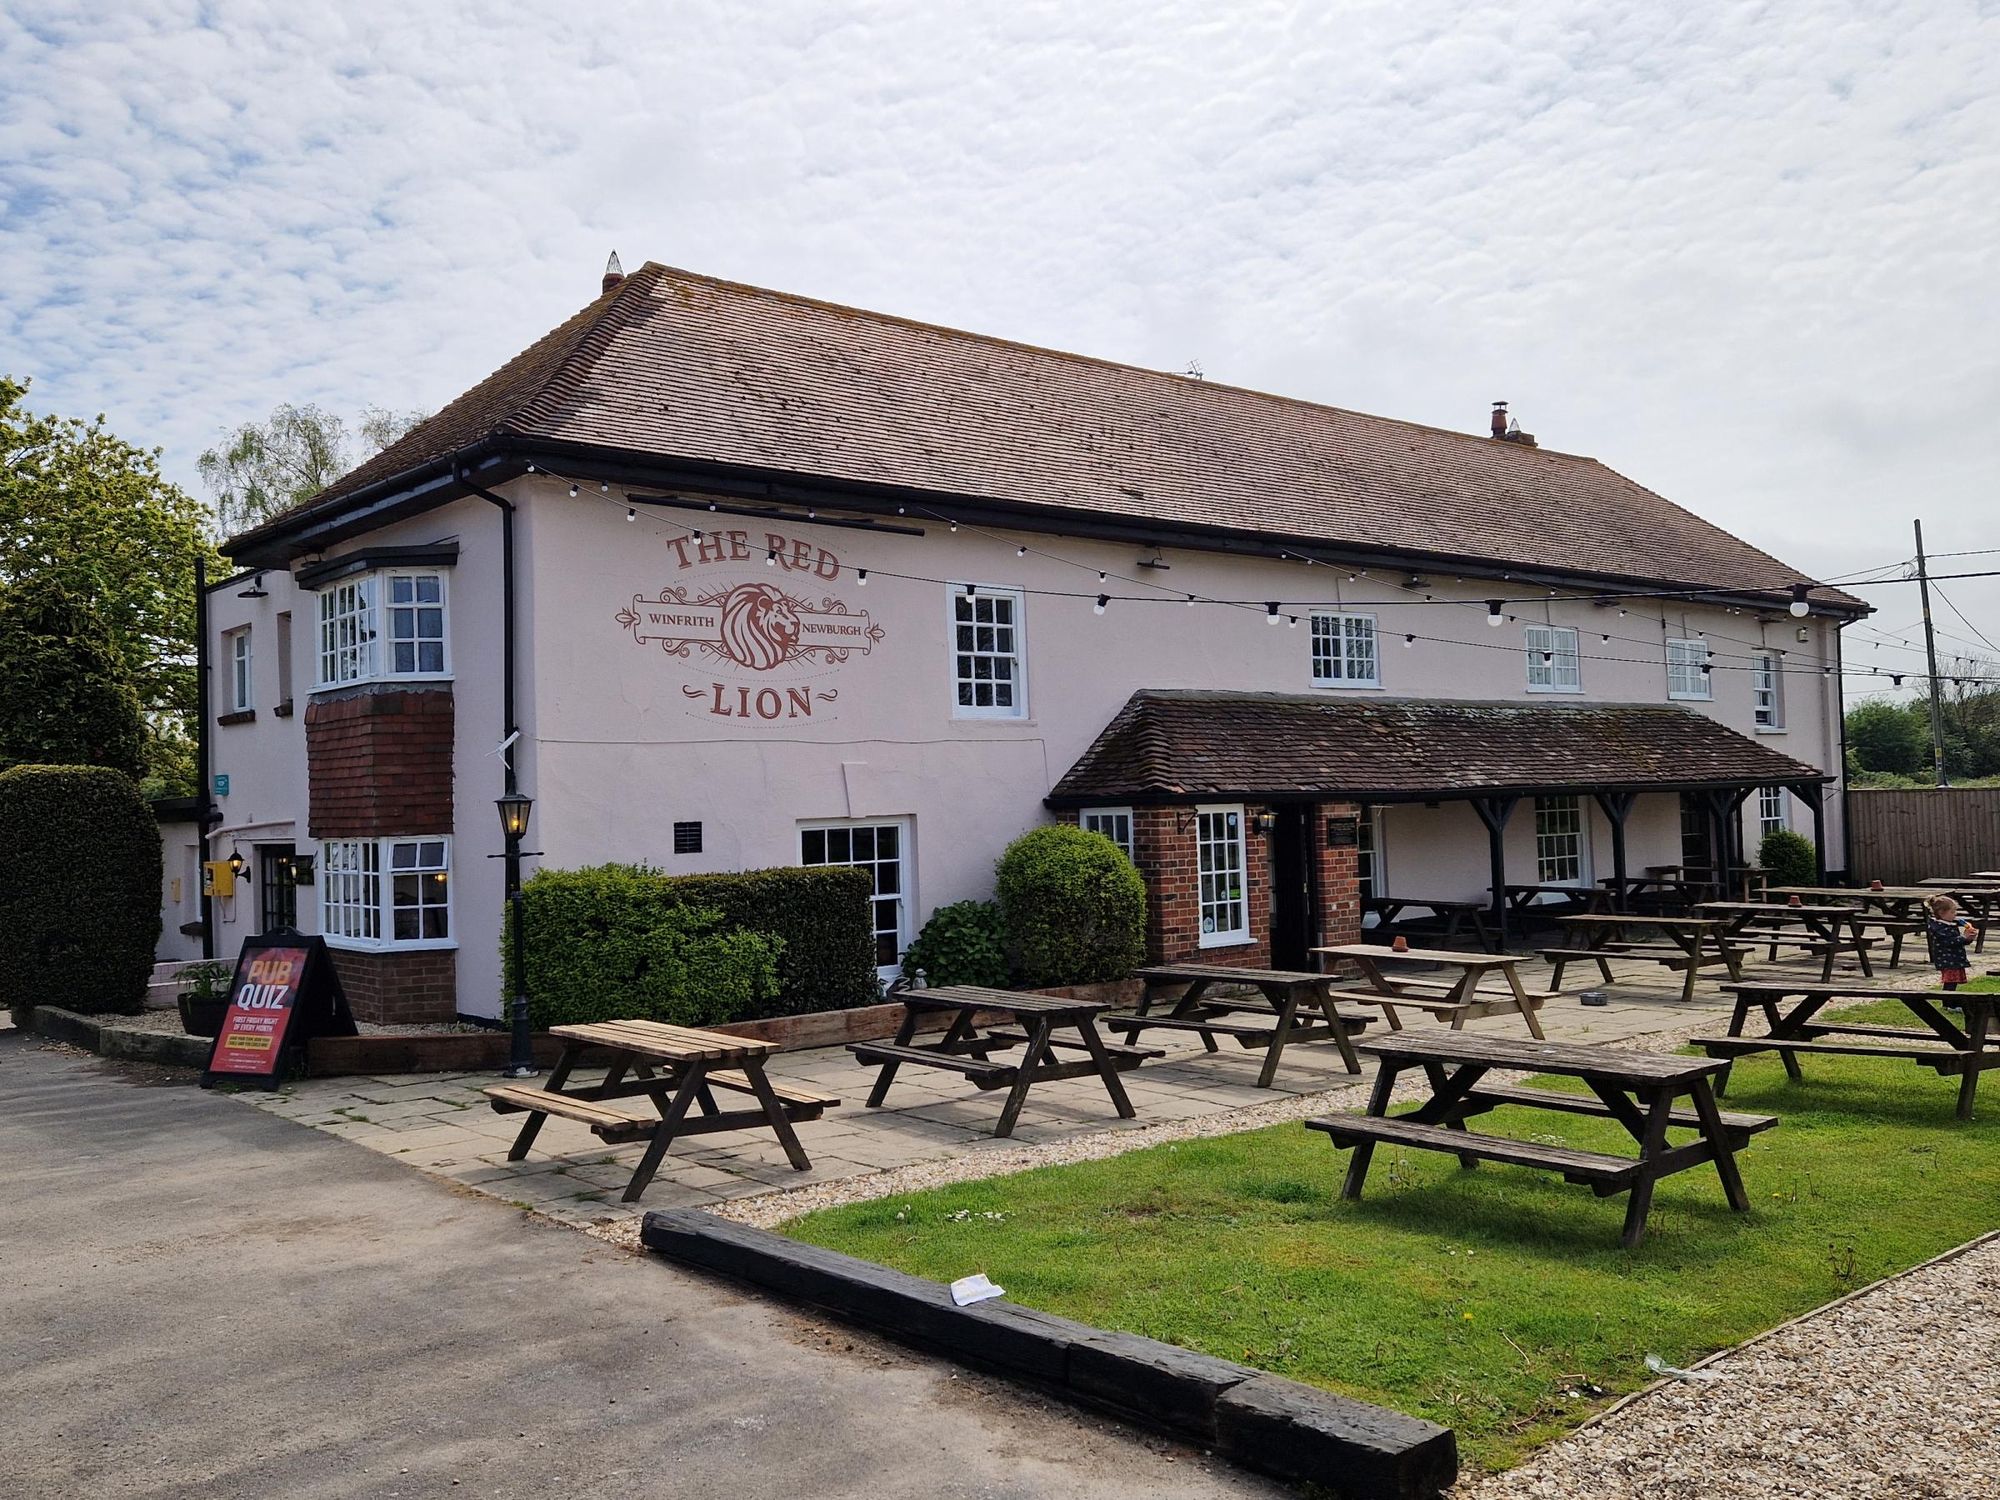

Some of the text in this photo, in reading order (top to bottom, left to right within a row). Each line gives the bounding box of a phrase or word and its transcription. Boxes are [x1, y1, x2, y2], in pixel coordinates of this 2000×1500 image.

[667, 530, 841, 581] THE RED
[648, 613, 861, 636] WINFRITH NEWBURGH
[710, 682, 813, 720] LION
[247, 960, 293, 985] PUB
[237, 983, 289, 1011] QUIZ
